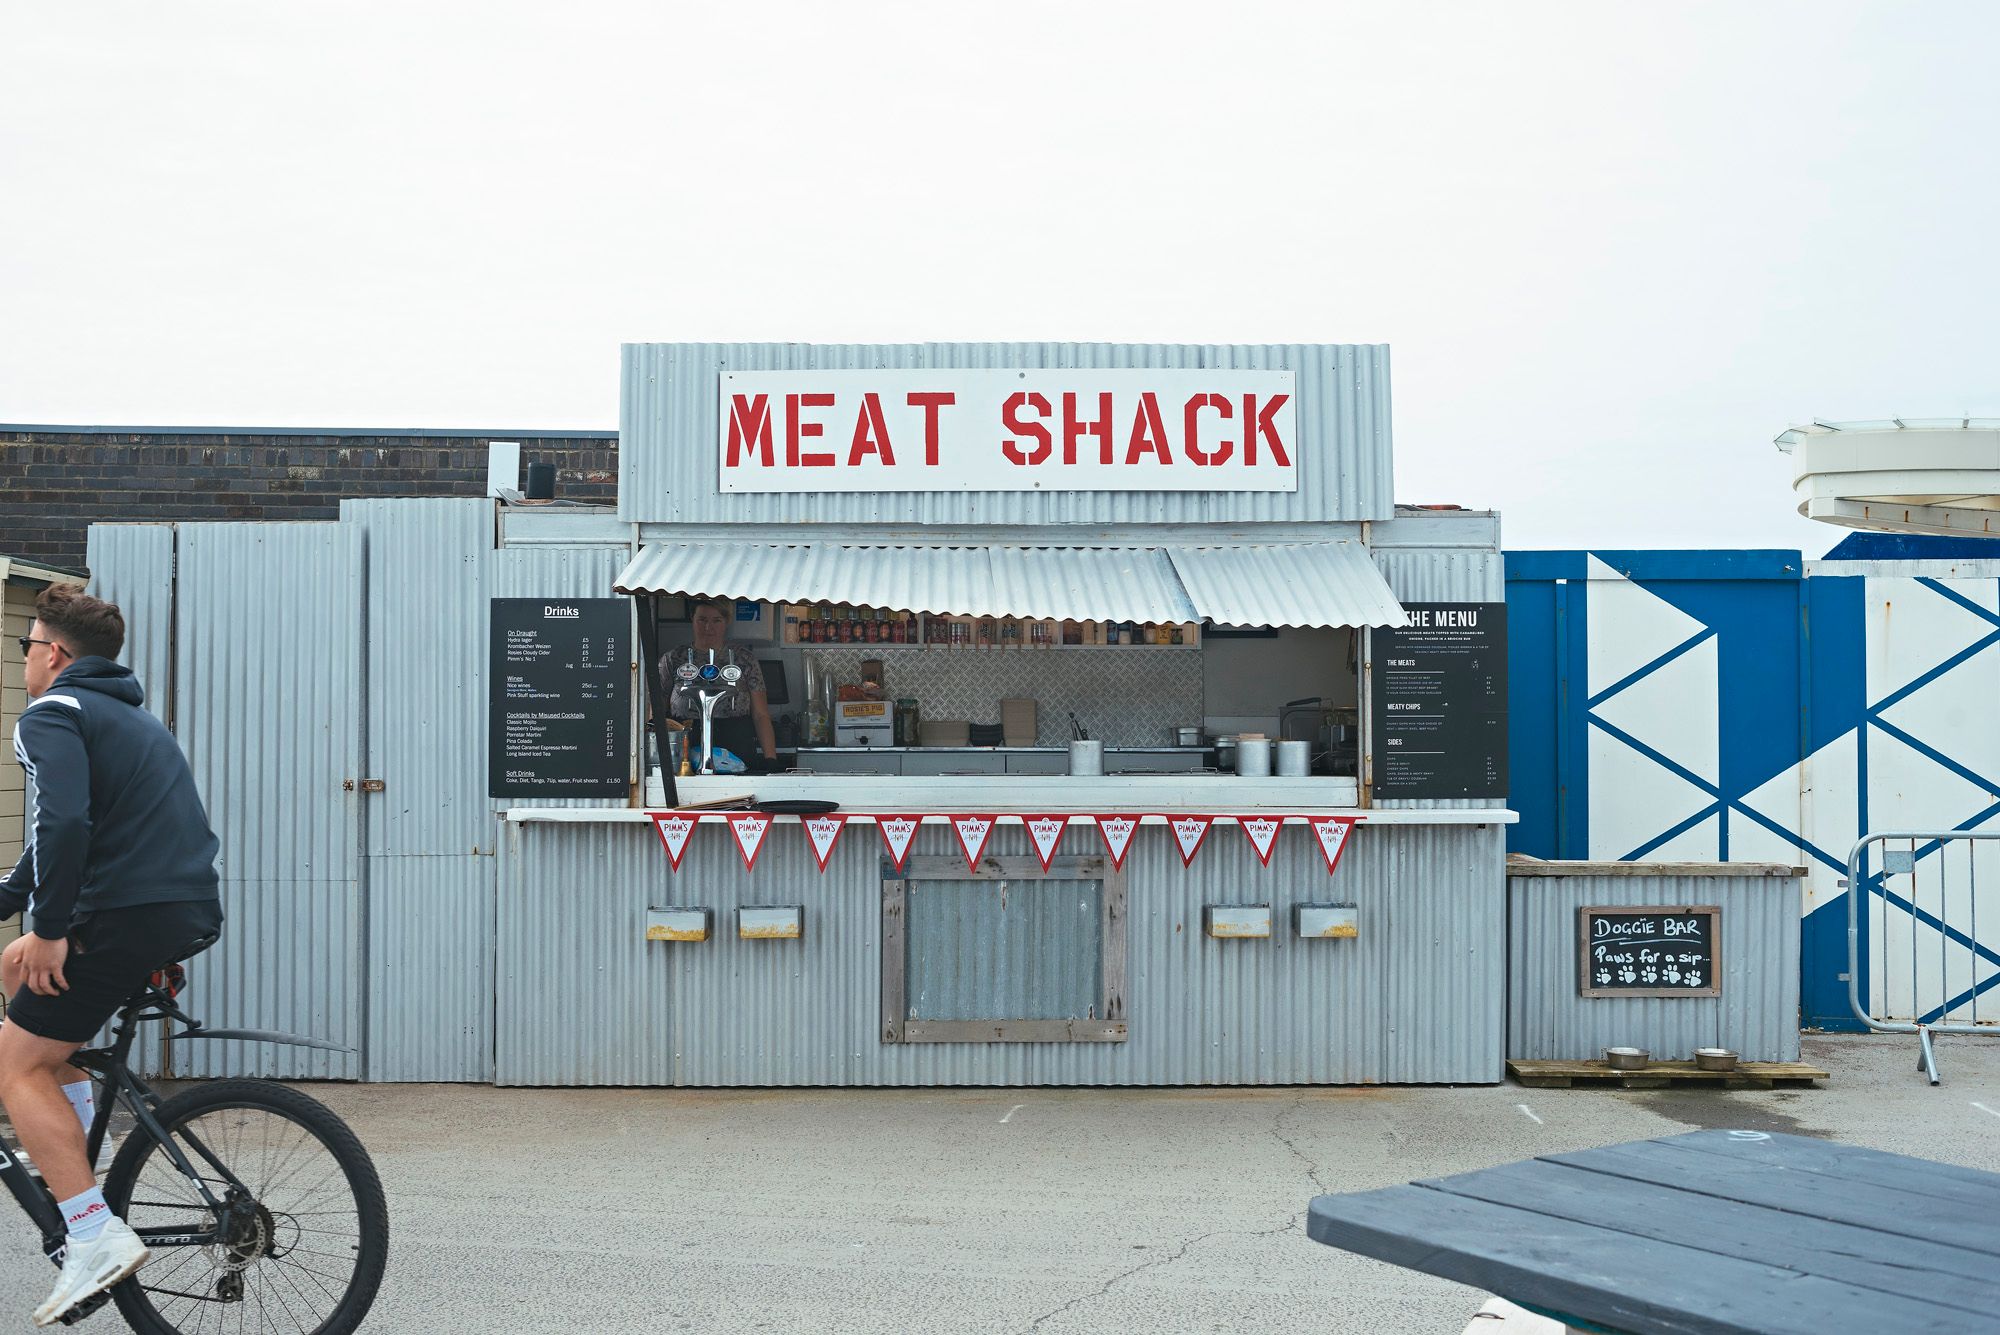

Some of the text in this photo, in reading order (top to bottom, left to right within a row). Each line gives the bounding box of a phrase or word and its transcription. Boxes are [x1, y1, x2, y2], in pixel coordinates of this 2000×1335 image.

[726, 392, 1291, 467] MEAT SHACK
[544, 606, 579, 616] Drinks
[1436, 611, 1477, 627] MENU
[664, 822, 687, 832] PIMM'S
[738, 822, 762, 832] PIMM'S
[812, 822, 836, 832] PIMM'S
[888, 823, 911, 832] PIMM'S
[961, 823, 985, 832] PIMM'S
[1034, 823, 1058, 832] PIMM'S
[1106, 824, 1130, 833] PIMM'S
[1178, 824, 1201, 833] PIMM'S
[1250, 823, 1274, 832] PIMM'S
[1321, 825, 1343, 835] PIMM'S
[1664, 918, 1701, 936] BAR
[1595, 946, 1634, 963] Paws
[1639, 949, 1660, 963] for
